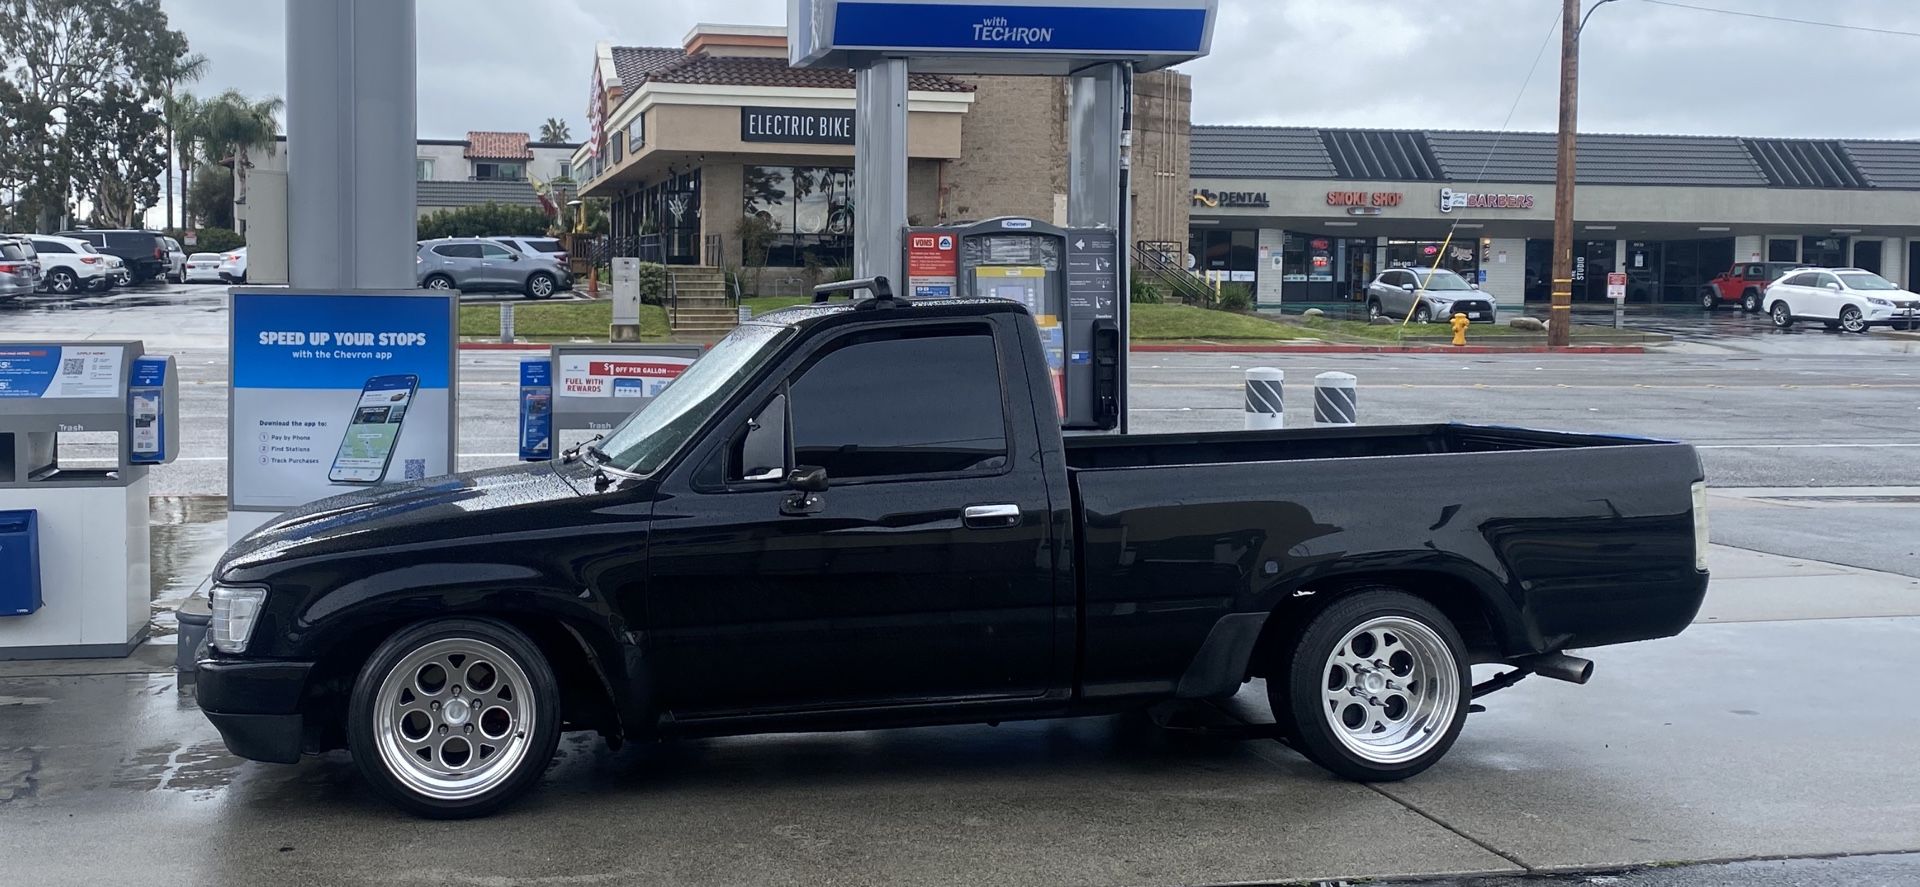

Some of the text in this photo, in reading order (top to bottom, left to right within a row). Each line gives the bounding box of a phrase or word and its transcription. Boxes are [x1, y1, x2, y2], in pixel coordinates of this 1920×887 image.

[983, 17, 1008, 26] with
[973, 24, 1053, 44] TECHRON
[749, 114, 851, 137] ELECTRIC BIKE
[1219, 192, 1270, 203] DENTAL
[1327, 192, 1403, 206] SMOKE SHOP
[1467, 193, 1534, 208] BARBERS
[915, 239, 933, 247] VONS
[1576, 256, 1585, 281] STUDIO
[259, 331, 427, 347] SPEED UP YOUR STOPS
[292, 350, 393, 360] with the Chevron app
[615, 366, 627, 374] OFF
[629, 366, 641, 374] PER
[642, 367, 667, 375] GALLON
[585, 378, 604, 386] WITH
[567, 384, 602, 393] REWARDS
